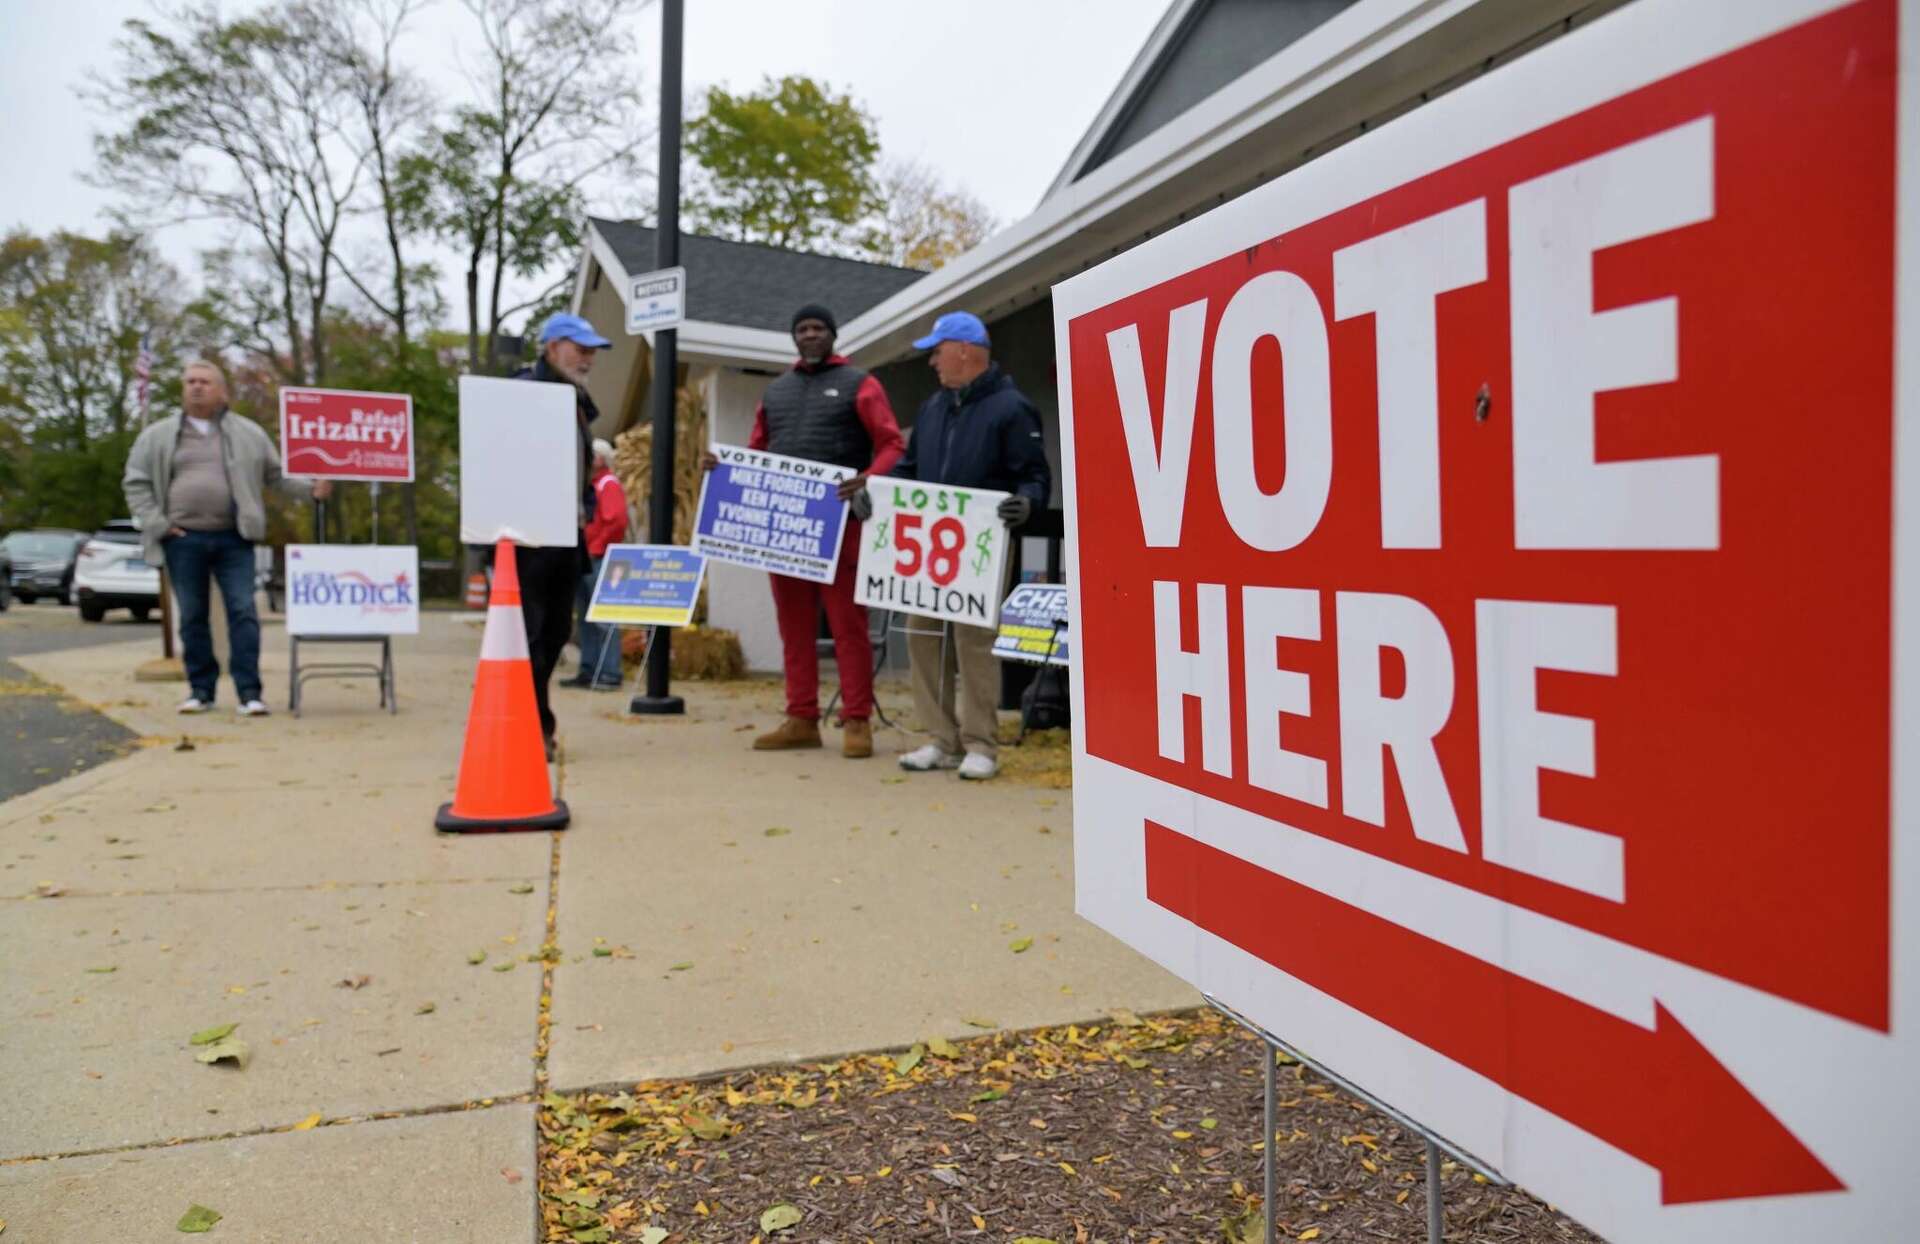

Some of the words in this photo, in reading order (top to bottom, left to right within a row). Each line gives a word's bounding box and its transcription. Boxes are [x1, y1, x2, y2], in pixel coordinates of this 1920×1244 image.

[1106, 114, 1721, 551] VOTE
[289, 413, 405, 451] Irizarry
[350, 409, 405, 428] Rafael
[719, 448, 771, 468] VOTE
[779, 459, 825, 477] ROW
[729, 466, 762, 488] MIKE
[763, 472, 827, 501] FIORELLO
[893, 486, 973, 515] LOST
[741, 487, 768, 509] KEN
[768, 491, 807, 516] PUGH
[718, 500, 770, 528] YVONNE
[772, 510, 825, 539] TEMPLE
[699, 538, 740, 555] BOARD
[744, 547, 759, 556] OF
[761, 549, 829, 570] EDUCATION
[711, 518, 769, 547] KRISTEN
[769, 529, 821, 557] ZAPATA
[894, 513, 965, 587] 58
[292, 583, 412, 605] HOYDICK
[866, 574, 986, 619] MILLION
[1010, 589, 1067, 611] CHE
[1152, 580, 1627, 905] HERE
